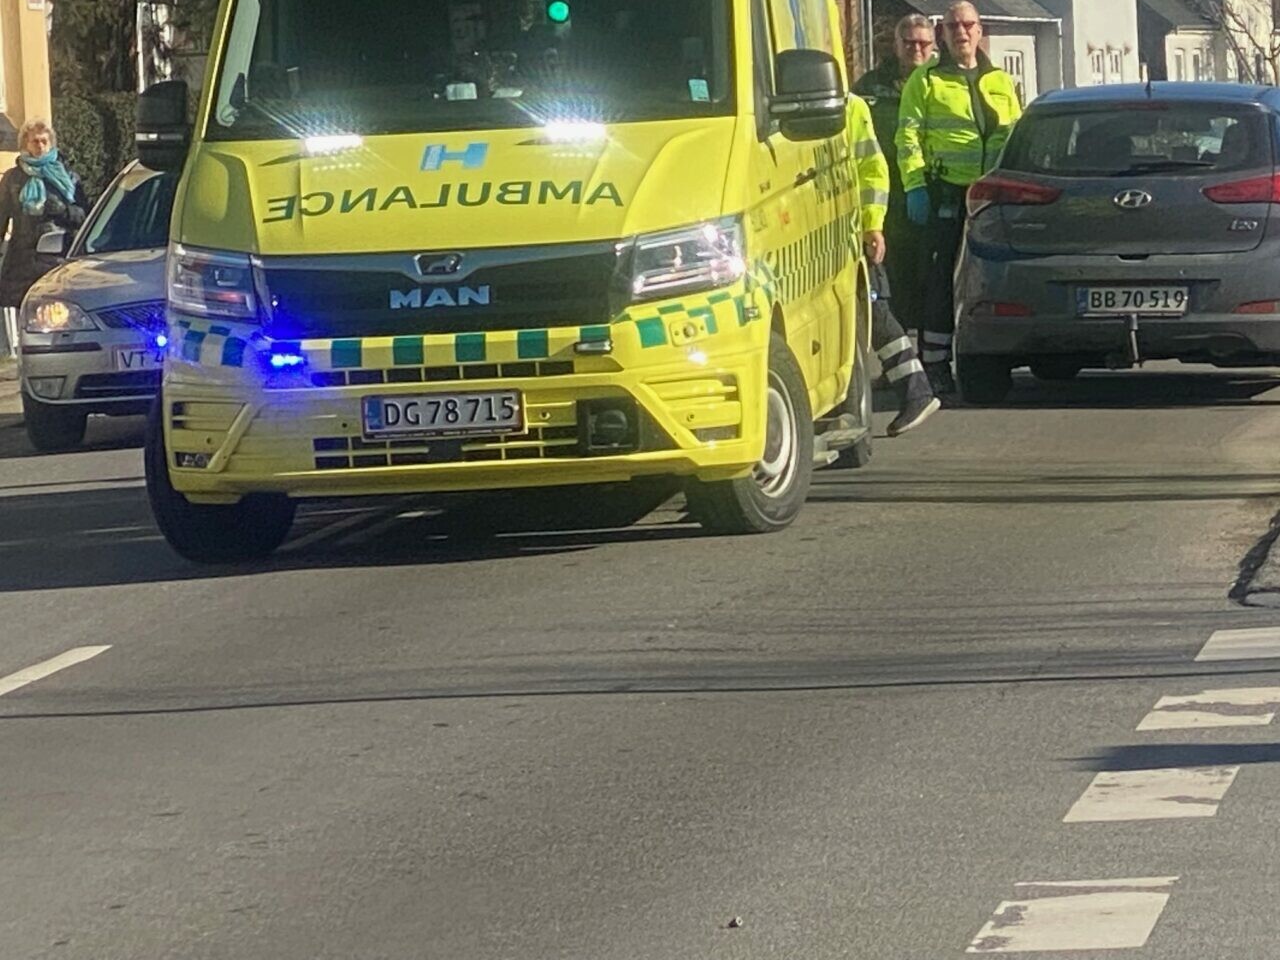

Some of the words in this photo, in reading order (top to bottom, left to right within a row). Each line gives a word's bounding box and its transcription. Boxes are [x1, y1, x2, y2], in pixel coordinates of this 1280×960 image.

[390, 285, 490, 309] MAN
[1091, 291, 1116, 308] BB
[1121, 291, 1144, 308] 70
[1149, 290, 1185, 308] 519
[384, 402, 421, 426] DG
[427, 399, 459, 424] 78
[466, 396, 515, 422] 715
